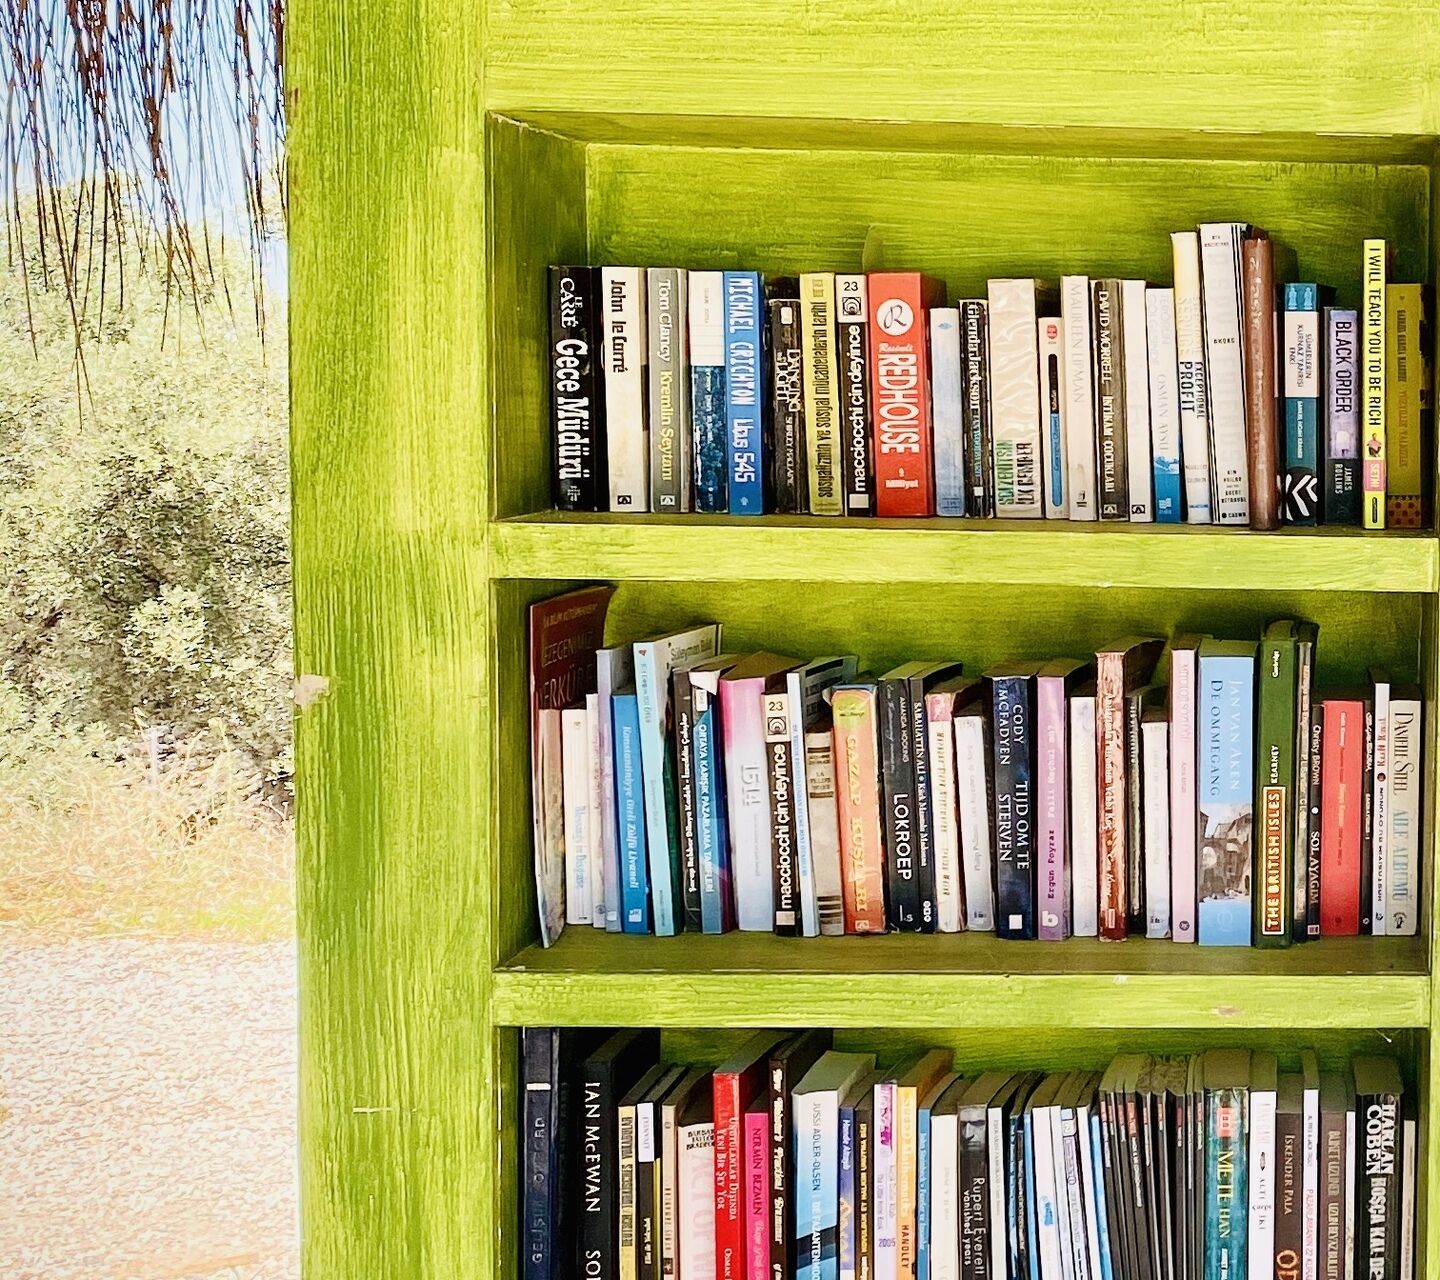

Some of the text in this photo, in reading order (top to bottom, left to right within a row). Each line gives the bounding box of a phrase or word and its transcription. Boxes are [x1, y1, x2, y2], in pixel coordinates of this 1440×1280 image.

[843, 281, 859, 292] 23
[1369, 255, 1380, 283] WILL
[560, 278, 577, 328] CARRÉ
[575, 297, 583, 307] LE
[658, 279, 671, 361] Tom Clancy
[1369, 288, 1380, 325] TEACH
[556, 338, 588, 392] Gece
[729, 278, 755, 405] MICHAEL CRICHTON
[967, 303, 980, 410] Glenda Jackson
[1098, 291, 1111, 384] DAVID MORRELL
[1289, 347, 1297, 365] ENKİ
[1305, 333, 1313, 379] SÜMERLERİN
[1335, 321, 1352, 412] BLACK ORDER
[1369, 331, 1380, 354] YOU
[1369, 357, 1380, 372] TO
[787, 349, 801, 412] DANCING
[847, 325, 866, 491] macciocchi çin deyince
[879, 354, 920, 453] REDHOUSE
[1180, 361, 1195, 412] PROFIT
[1194, 361, 1205, 419] EXCEPTIONAL
[1369, 377, 1380, 392] BE
[1369, 396, 1380, 426] RICH
[557, 396, 589, 479] Müdürü
[659, 370, 674, 480] Kremlin Şeytanı
[1335, 463, 1344, 494] ROLLINS
[1344, 467, 1352, 490] JAMES
[1370, 463, 1379, 487] SETHI
[769, 702, 783, 712] 23
[900, 697, 909, 762] AMANDA HOCKING
[914, 702, 925, 774] SABAHATTİN ALİ
[999, 689, 1010, 765] MCFADYEN
[1013, 704, 1024, 744] CODY
[1210, 680, 1223, 797] DE OMMEGANG
[741, 764, 760, 806] 1514
[1271, 746, 1279, 784] KEARNEY
[1310, 725, 1321, 785] Christy BROWN
[1393, 712, 1414, 795] DANIELLE STEEL
[623, 726, 640, 888] Konstantiniyye Oteli Zülfü Livaneli
[771, 744, 791, 908] macciocchi çin deyince
[894, 794, 912, 880] LOKROEP
[998, 794, 1012, 861] STERVEN
[1014, 780, 1029, 870] TIJD OM TE
[1268, 792, 1281, 928] THE BRITISH ISLES
[585, 1082, 600, 1212] IAN McEWAN
[727, 1117, 739, 1220] UNUTULANLAR DIŞINDA
[773, 1069, 784, 1244] New Webster's Practical Grammar
[812, 1102, 821, 1191] JUSSI ADLER-OLSEN
[1328, 1130, 1340, 1196] BUKET UZUNER
[1366, 1105, 1381, 1175] COBEN
[1381, 1103, 1394, 1174] HARLAN
[752, 1128, 763, 1215] NERMİN BEZMEN
[1367, 1177, 1387, 1225] HOŞÇA
[811, 1202, 821, 1218] DE
[962, 1190, 973, 1265] vanished years
[972, 1177, 985, 1274] Rupert Everett
[1305, 1189, 1314, 1246] PAZARLAMANIN
[1369, 1227, 1385, 1253] KAL
[724, 1248, 733, 1276] OSMAN
[878, 1238, 895, 1248] 2005
[901, 1224, 910, 1269] HANDLEY
